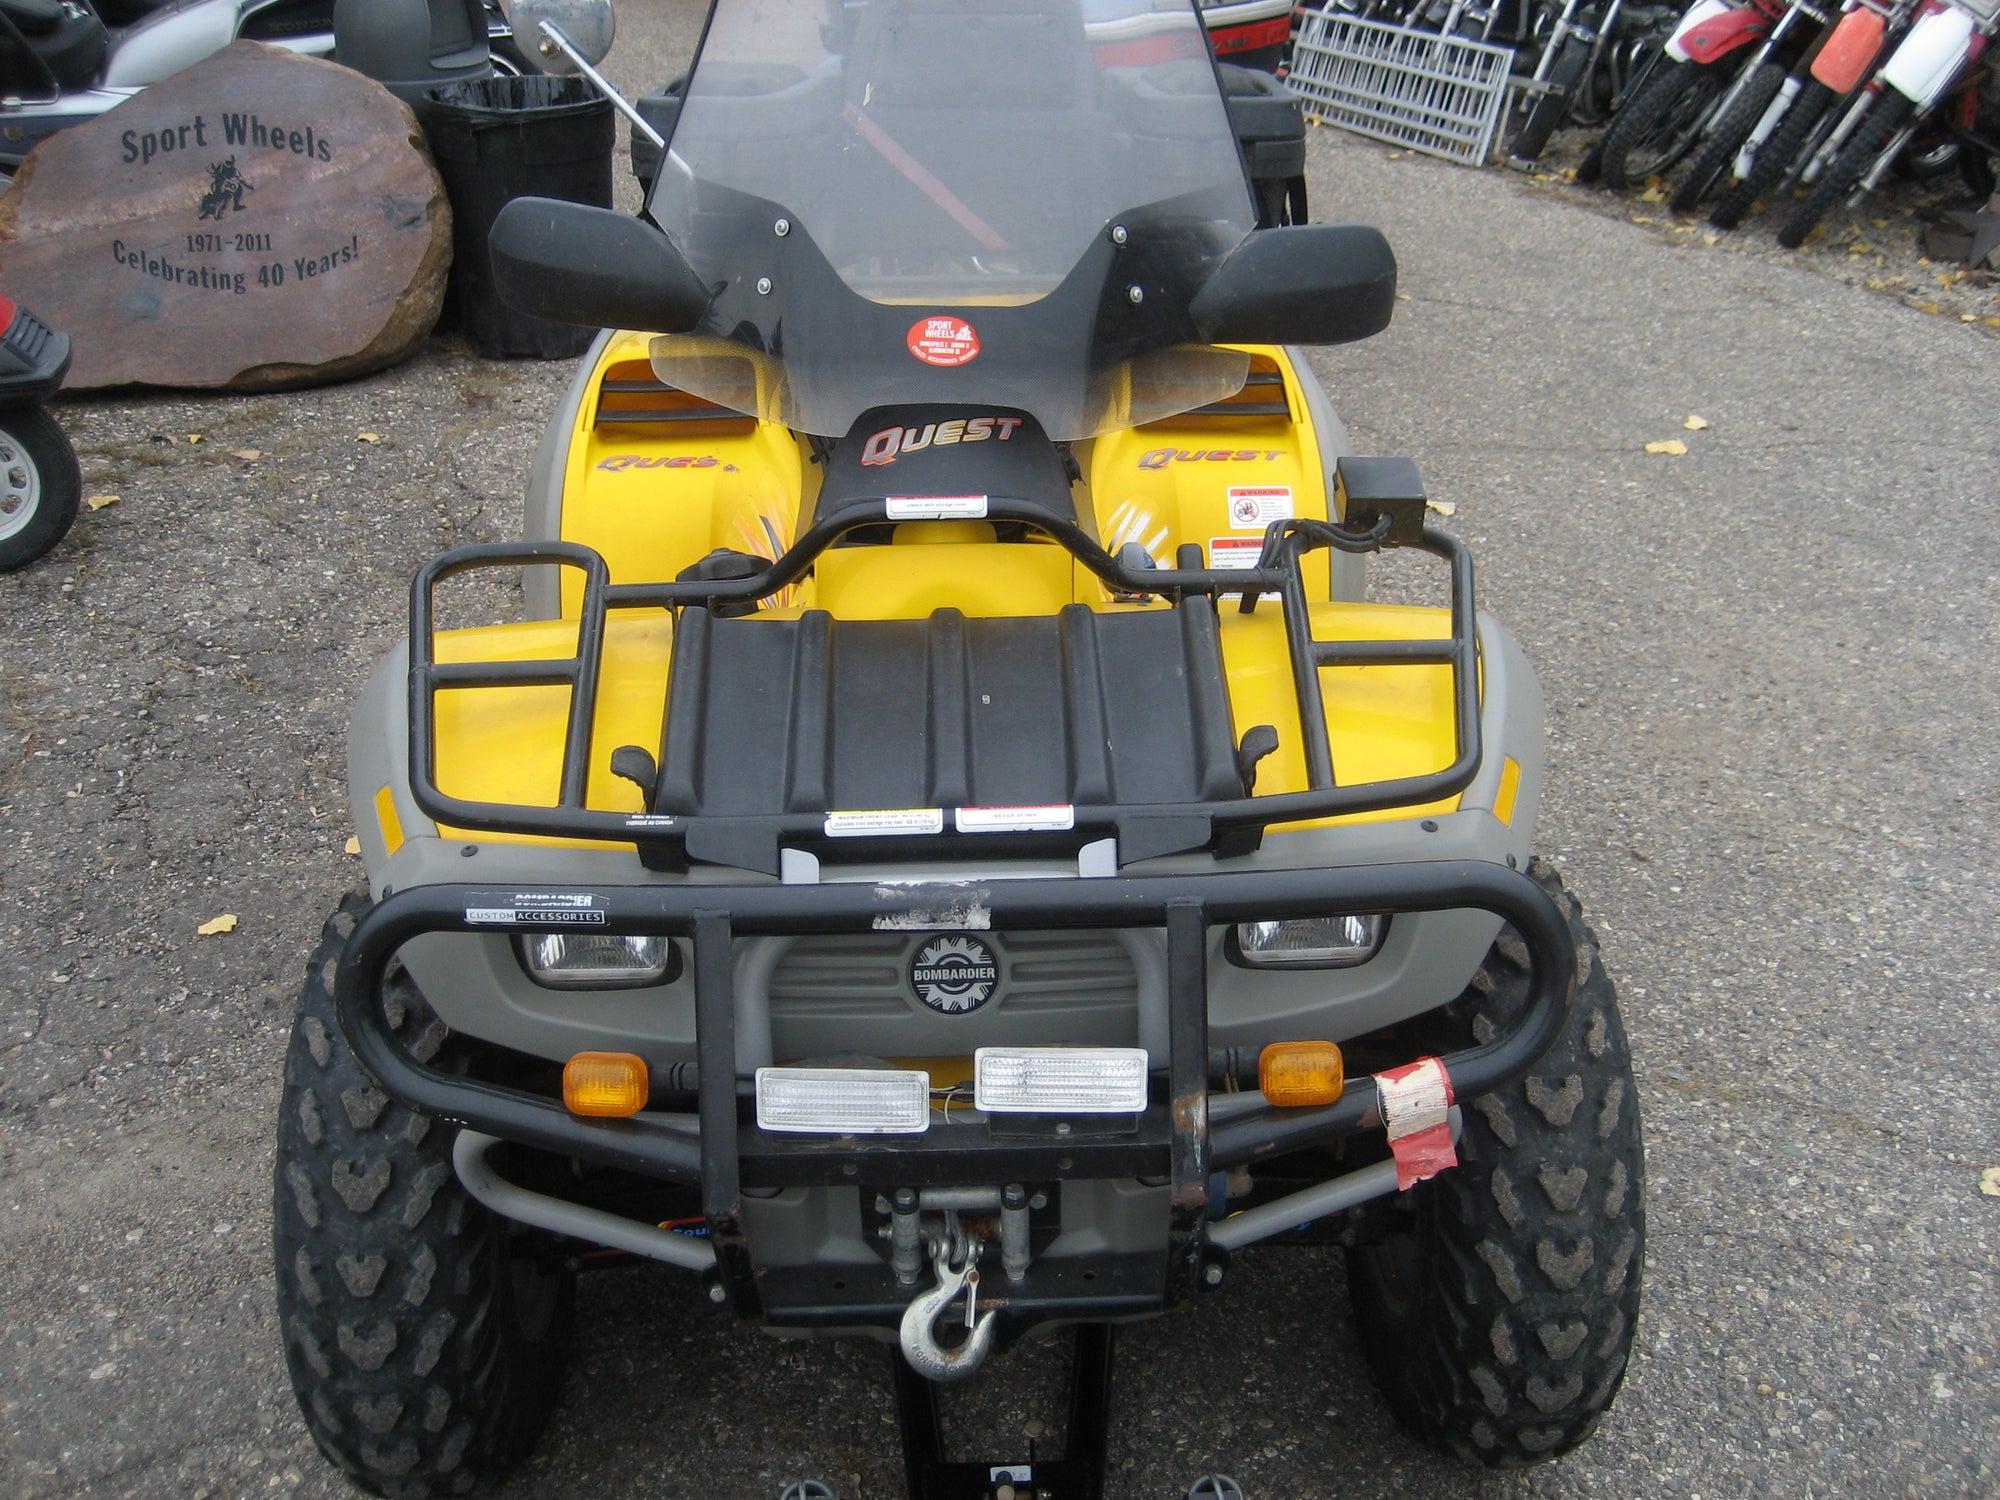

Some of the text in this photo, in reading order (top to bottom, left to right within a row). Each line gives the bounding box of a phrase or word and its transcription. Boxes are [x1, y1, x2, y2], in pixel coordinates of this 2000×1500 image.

[121, 113, 332, 165] Sport Wheels
[186, 234, 272, 252] 1971-2011
[112, 235, 359, 294] Celebrating 40 Years!
[925, 329, 956, 339] WHEELS
[927, 320, 953, 330] SPORT
[861, 417, 1024, 466] QUEST
[596, 455, 739, 473] QUES
[1138, 448, 1288, 471] QUEST
[514, 894, 593, 907] BOMBARDIER
[469, 912, 601, 921] CUSTOM ACCESSORIES
[913, 967, 996, 981] BOMBARDIER
